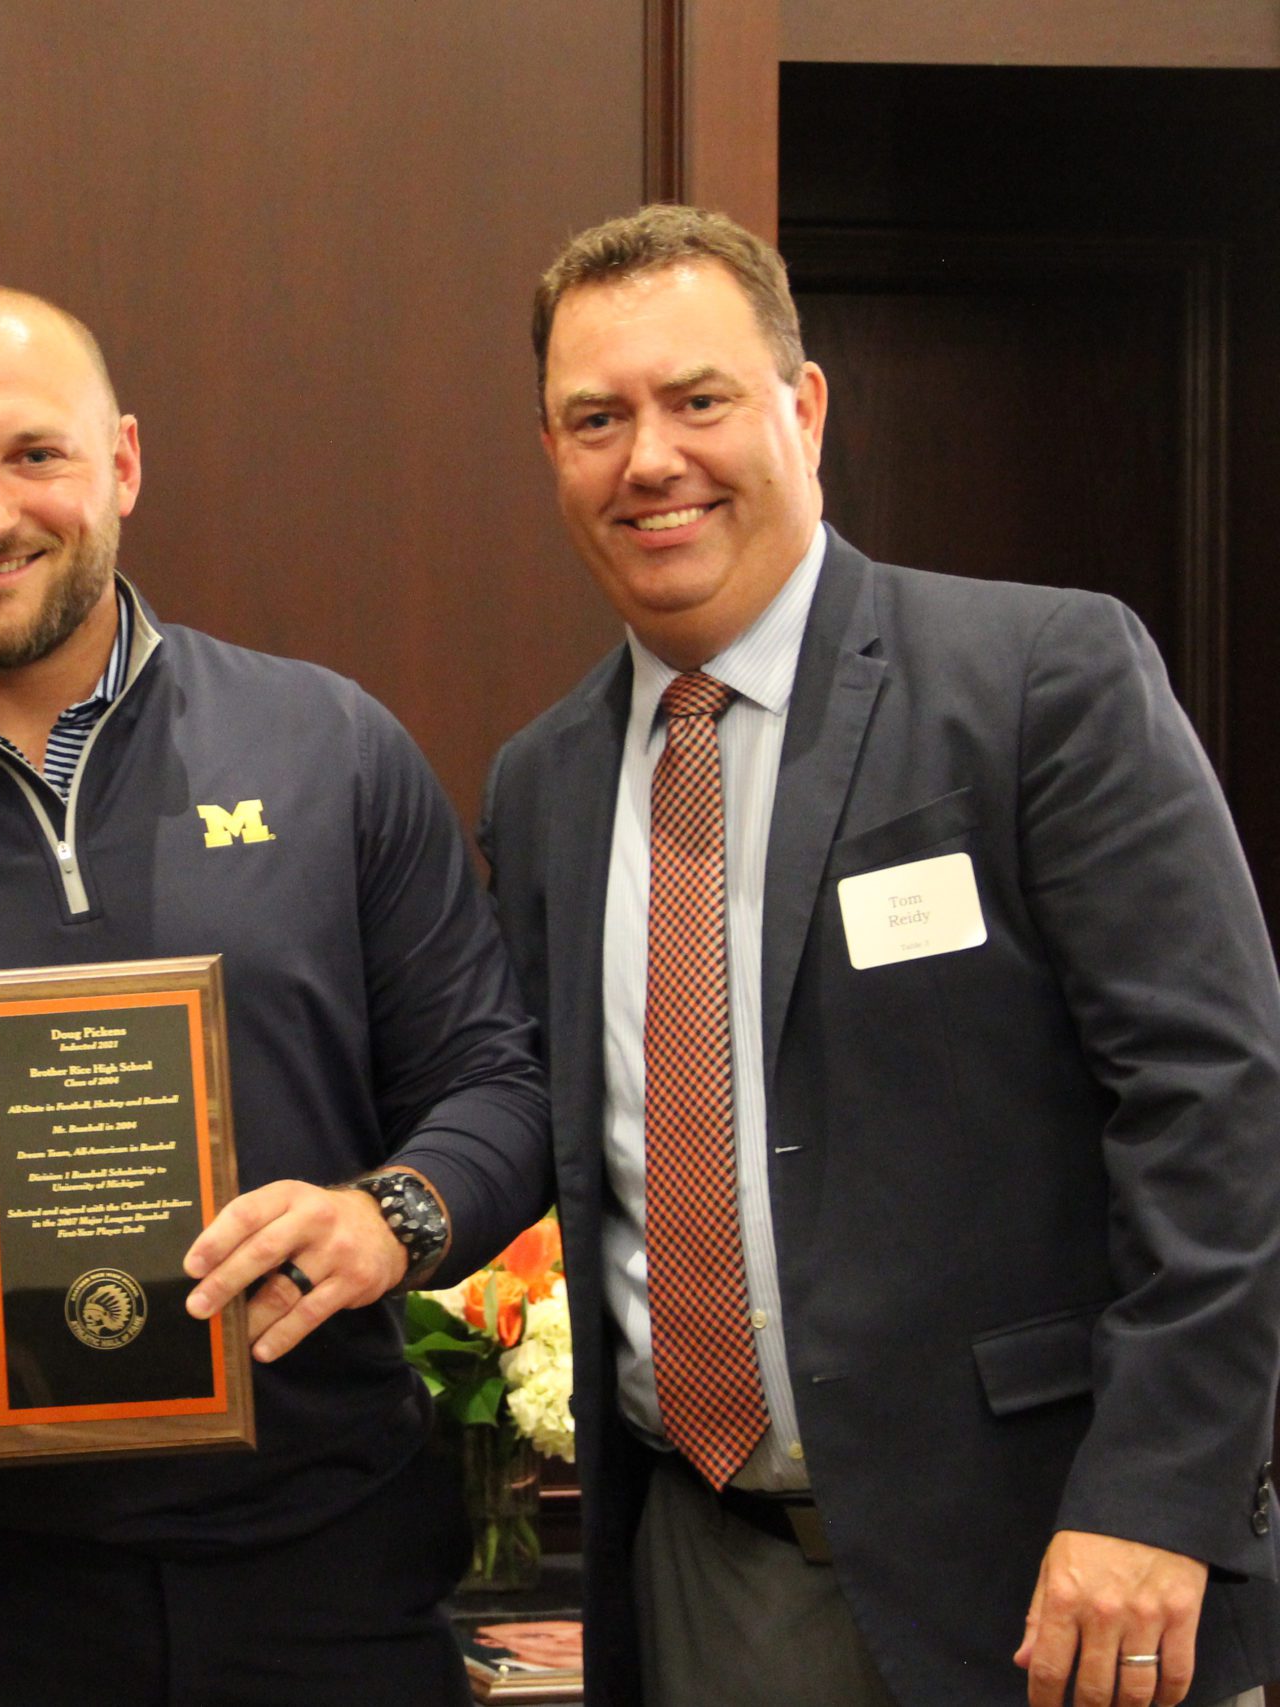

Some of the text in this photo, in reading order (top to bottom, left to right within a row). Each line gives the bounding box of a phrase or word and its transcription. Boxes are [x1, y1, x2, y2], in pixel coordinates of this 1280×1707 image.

[196, 799, 270, 848] M
[888, 894, 923, 908] Tom
[888, 910, 930, 928] Reidy
[51, 1027, 127, 1040] Doug Pickens
[60, 1042, 96, 1052] Inducted
[30, 1061, 152, 1078] Brother Rice High School
[64, 1078, 86, 1087] Class
[88, 1077, 97, 1085] of
[8, 1104, 44, 1114] All-State
[56, 1100, 92, 1111] Football,
[93, 1099, 124, 1108] Hockey
[125, 1097, 142, 1106] and
[143, 1094, 179, 1105] Baseball
[52, 1125, 68, 1134] Mr.
[69, 1123, 104, 1133] Baseball
[105, 1122, 114, 1131] in
[16, 1141, 176, 1160] Dream Team, All-American in Baseball
[28, 1173, 63, 1182] Division
[71, 1168, 108, 1179] Baseball
[108, 1166, 156, 1177] Scholarship
[52, 1179, 145, 1192] University of Michigan
[7, 1199, 192, 1218] Selected and signed with the Cleveland Indians
[32, 1219, 41, 1228] in
[42, 1219, 56, 1228] the
[78, 1216, 103, 1226] Major
[103, 1215, 134, 1224] League
[134, 1211, 170, 1221] Baseball
[96, 1227, 122, 1236] Player
[122, 1225, 146, 1234] Draft
